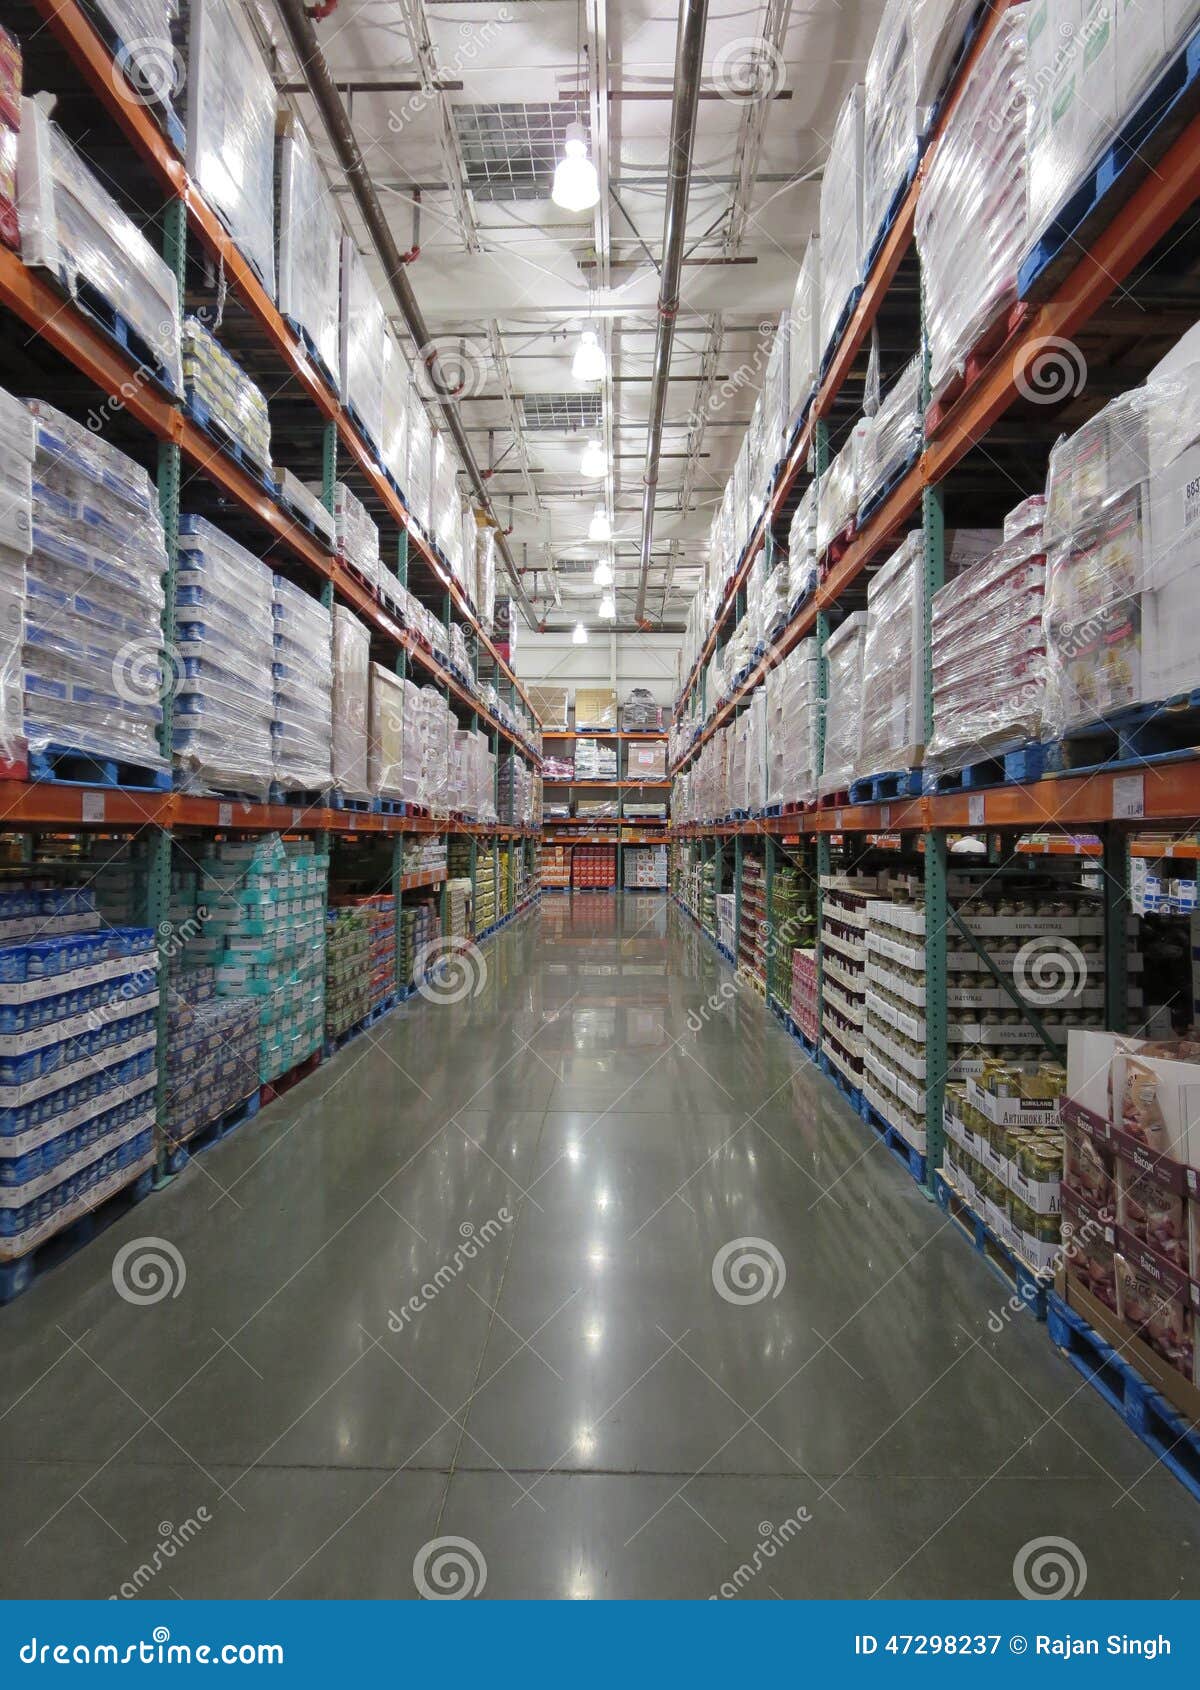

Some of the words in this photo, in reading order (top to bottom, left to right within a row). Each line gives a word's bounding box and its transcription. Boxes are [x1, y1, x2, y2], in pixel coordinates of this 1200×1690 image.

[1187, 477, 1200, 499] 883
[1003, 1111, 1043, 1125] ARTICHOKE
[1133, 1151, 1154, 1174] Bacon
[1140, 1255, 1161, 1280] Bacon
